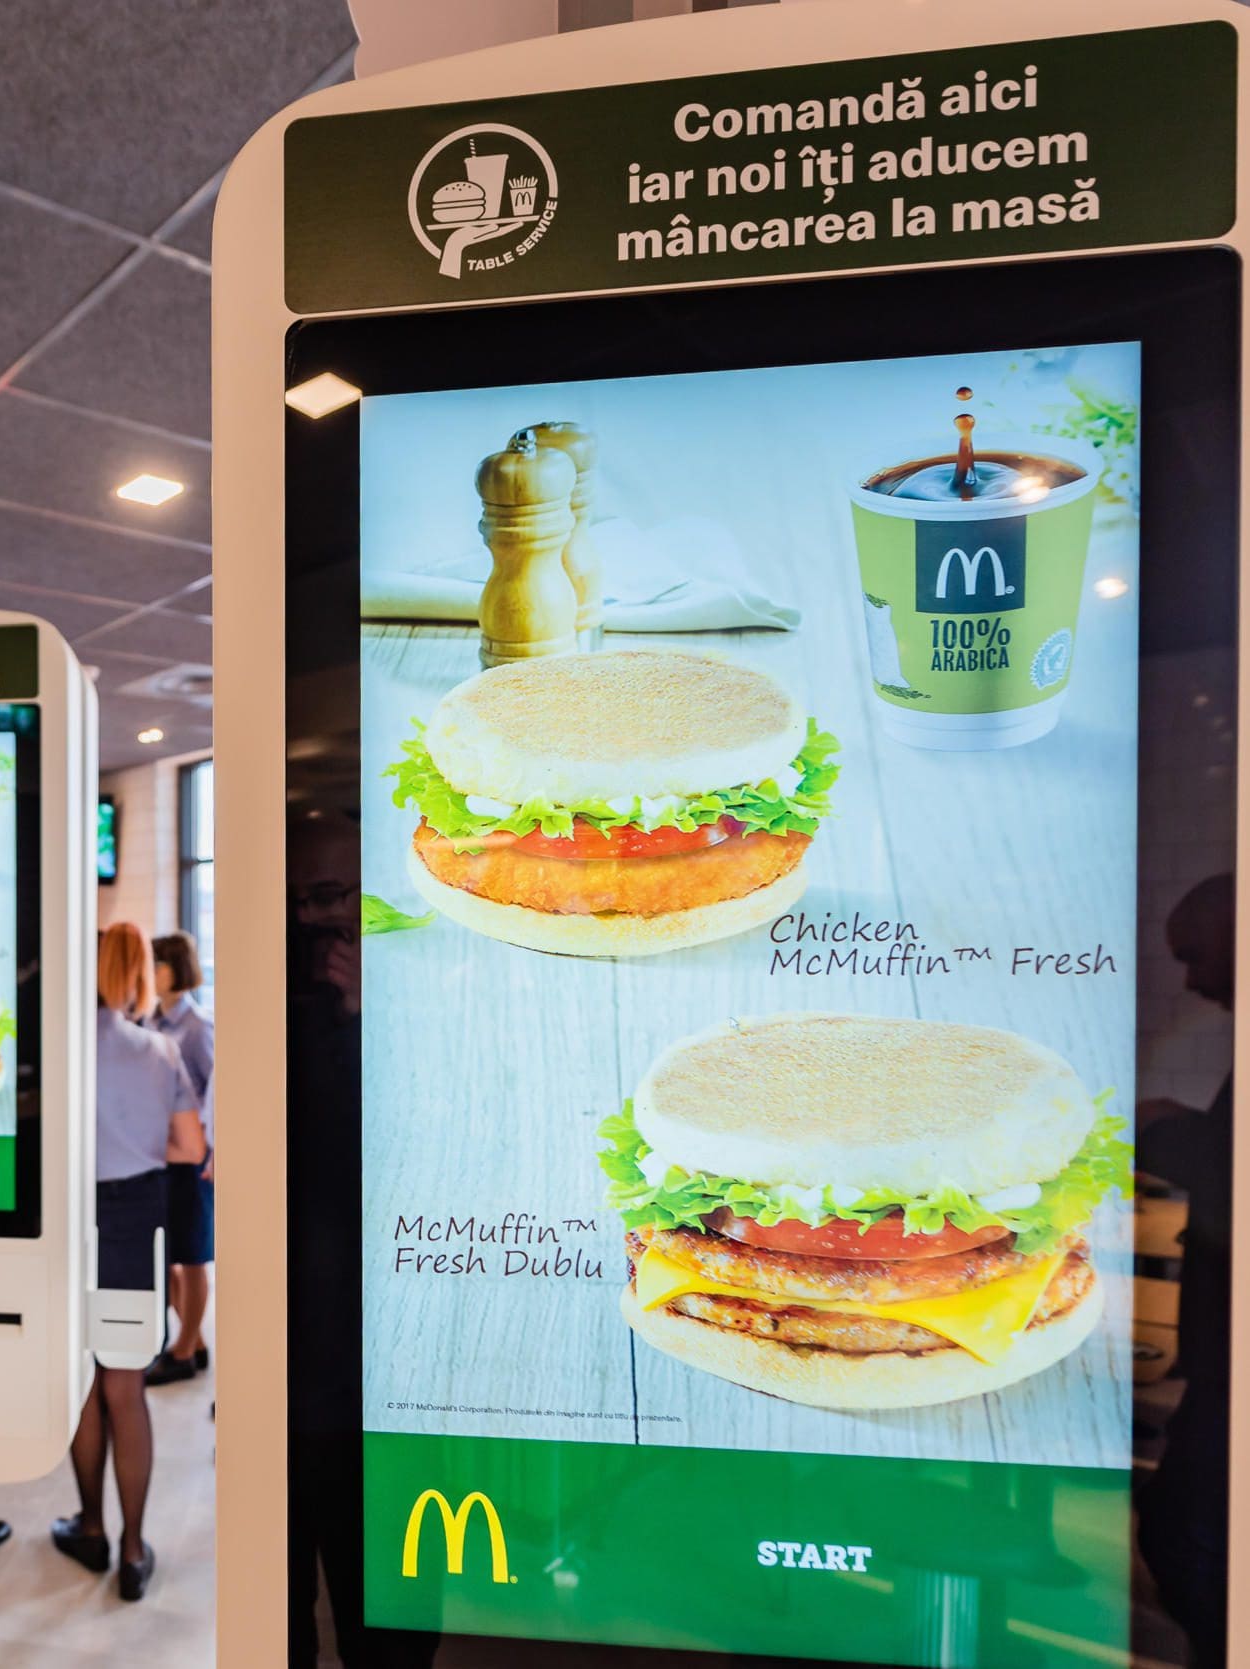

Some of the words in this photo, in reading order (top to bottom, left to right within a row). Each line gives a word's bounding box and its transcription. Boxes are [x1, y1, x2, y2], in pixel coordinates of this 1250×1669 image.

[673, 76, 926, 142] Comandă
[940, 64, 1038, 117] aici
[628, 162, 695, 204] iar
[707, 148, 787, 193] noi
[798, 141, 855, 204] îți
[867, 131, 1089, 182] aducem
[617, 212, 877, 261] mâncarea
[891, 196, 936, 238] la
[952, 176, 1101, 233] masă
[467, 251, 516, 272] TABLE
[515, 200, 558, 256] SERVICE
[930, 617, 1011, 649] 100%
[931, 646, 1011, 671] ARABICA
[770, 912, 920, 943] Chicken
[1011, 944, 1118, 976] Fresh
[395, 1246, 487, 1276] Fresh
[504, 1246, 604, 1279] Dublu
[396, 1402, 415, 1410] 2017
[757, 1540, 873, 1573] START
